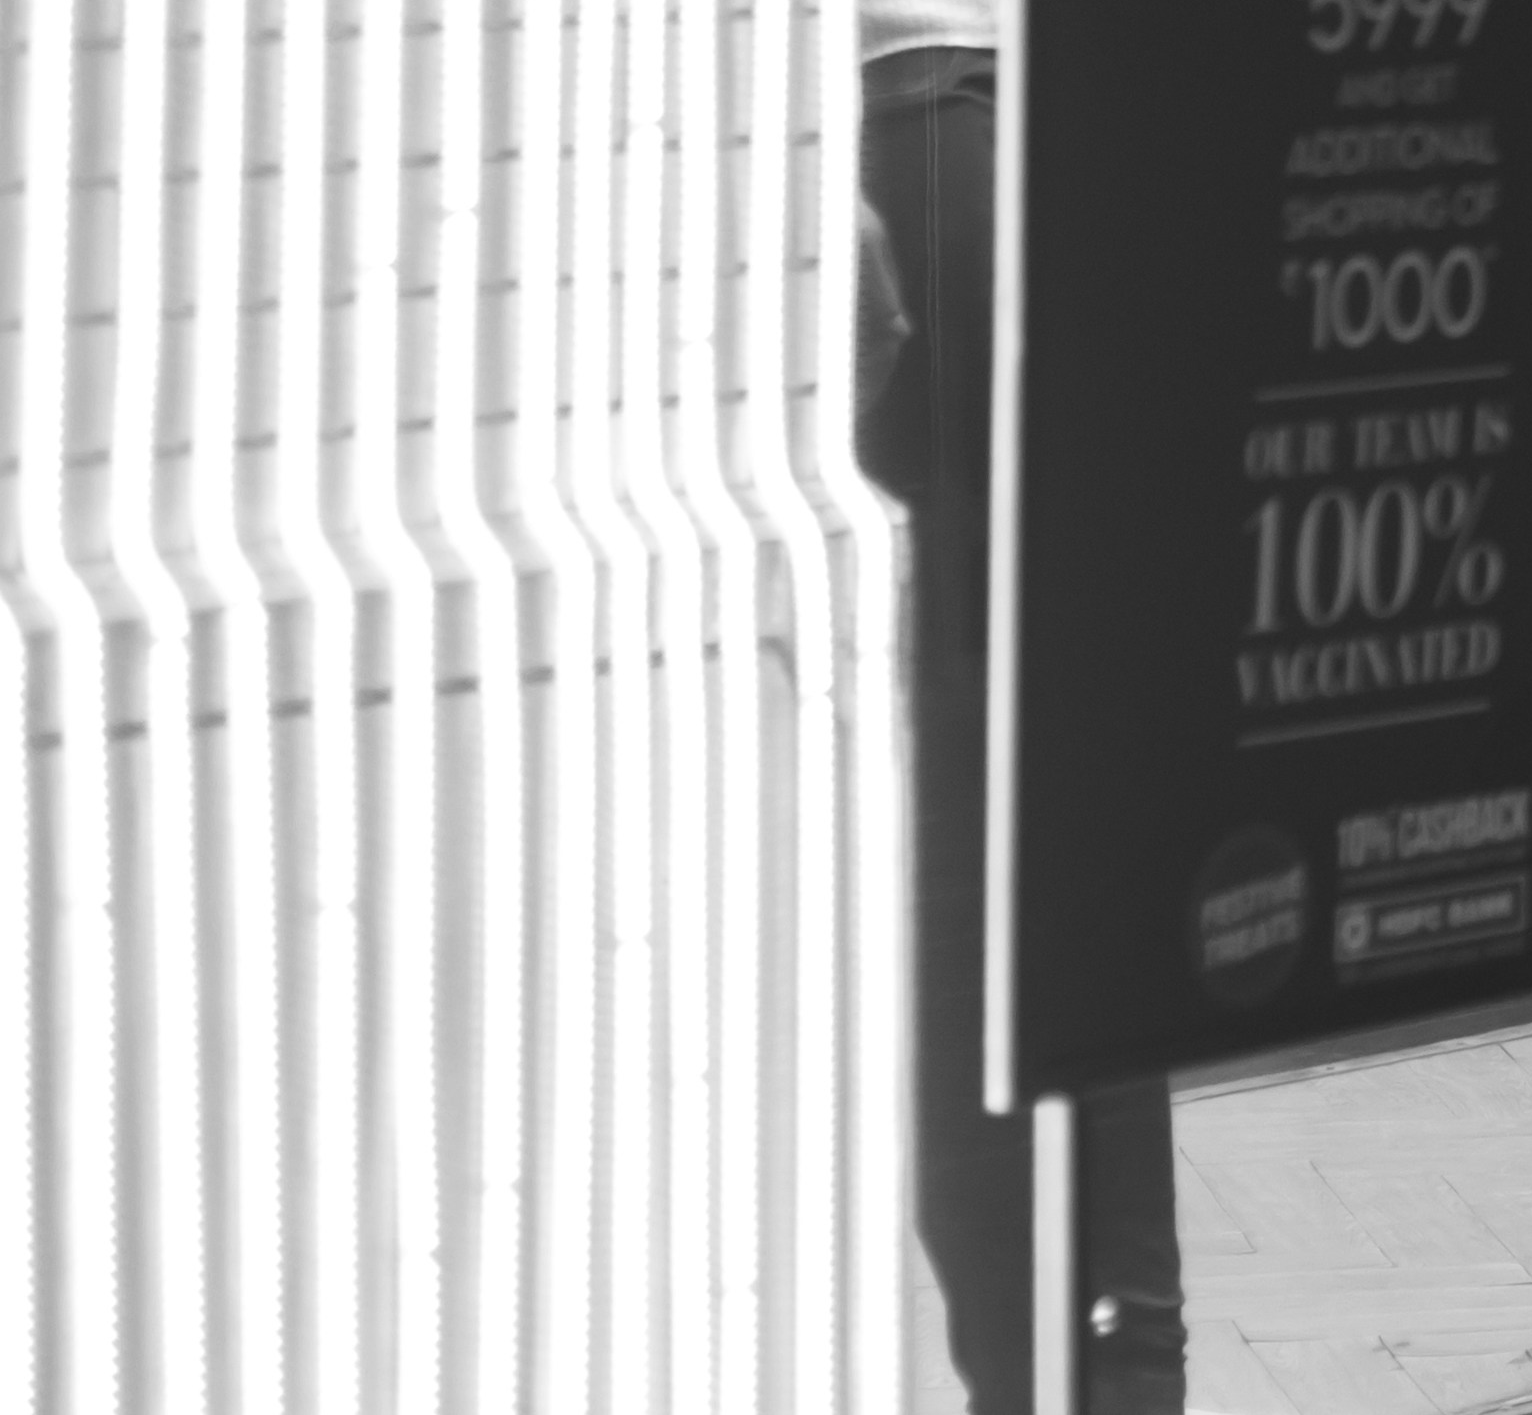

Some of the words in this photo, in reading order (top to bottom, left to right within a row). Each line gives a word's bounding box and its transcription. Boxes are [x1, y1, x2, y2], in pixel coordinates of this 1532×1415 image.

[1285, 117, 1503, 178] ADDITIONAL
[1281, 183, 1448, 244] SHOPPING
[1450, 178, 1501, 229] OF
[1242, 416, 1337, 481] OUR
[1350, 403, 1464, 472] TEAM
[1469, 399, 1514, 455] IS
[1240, 470, 1508, 637] 100%
[1235, 616, 1503, 706] VACCINATED
